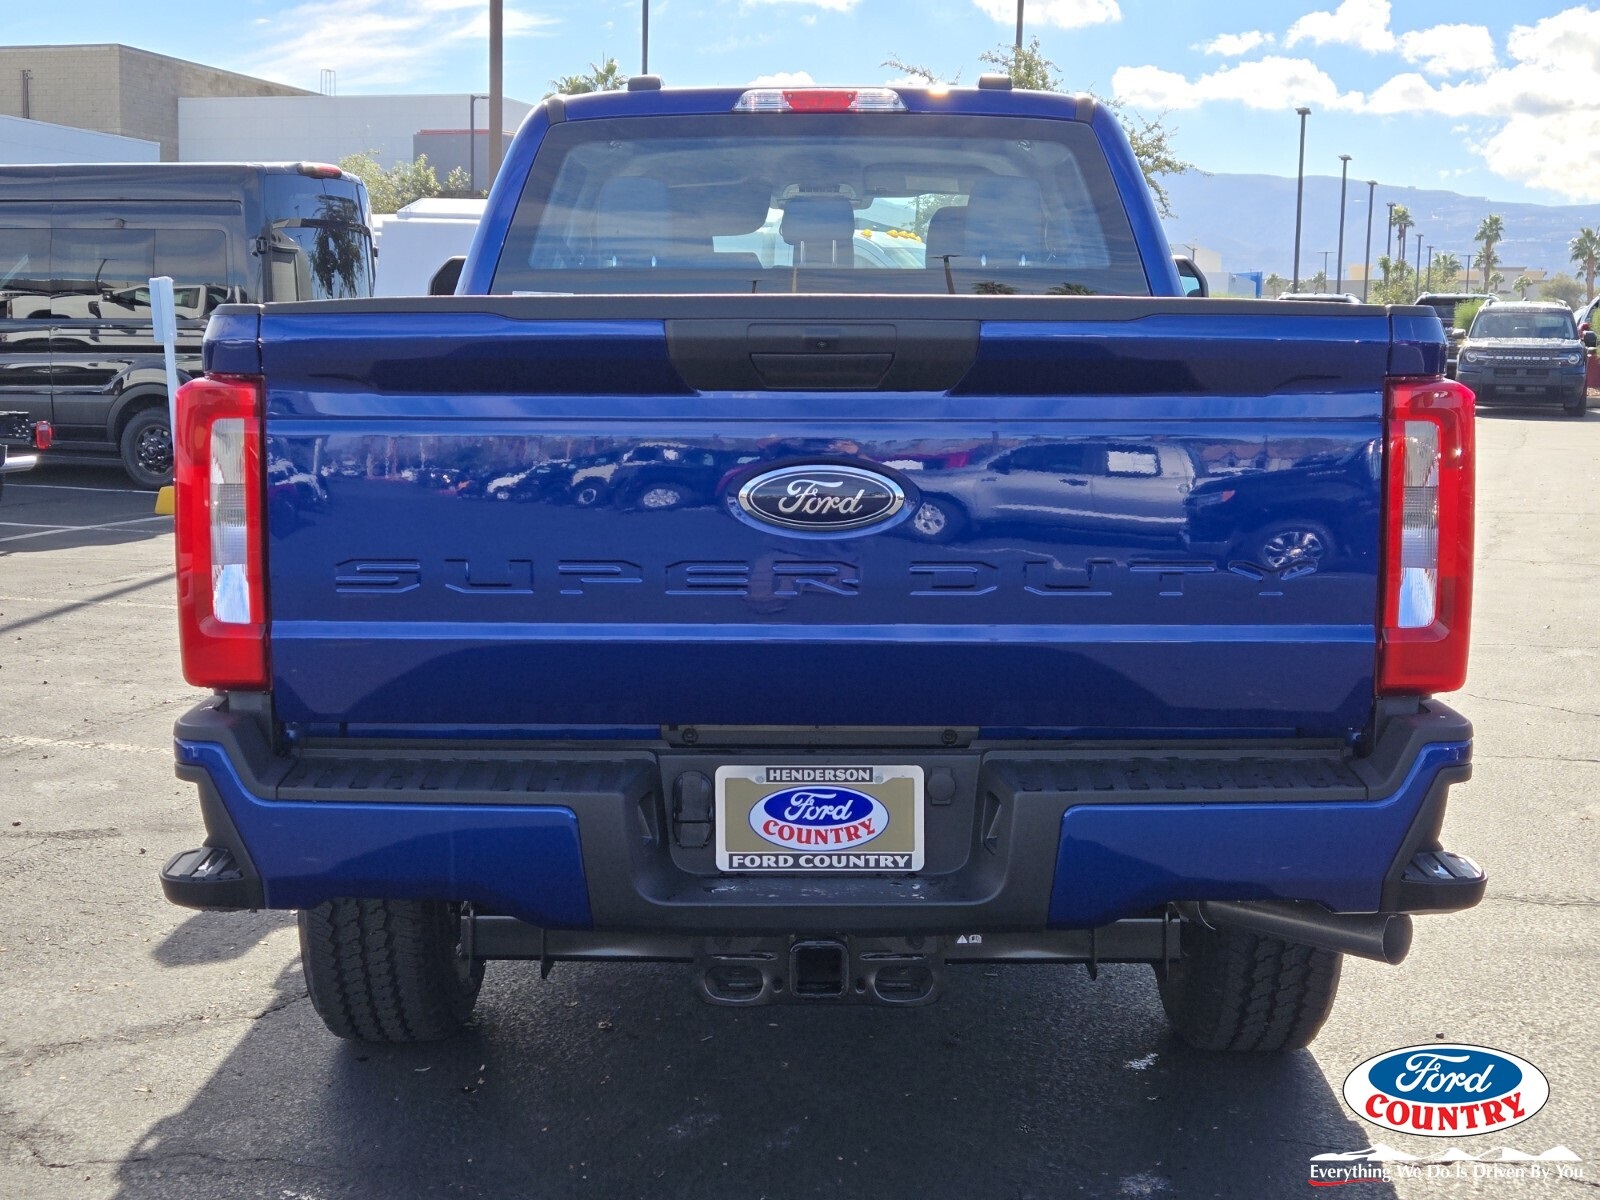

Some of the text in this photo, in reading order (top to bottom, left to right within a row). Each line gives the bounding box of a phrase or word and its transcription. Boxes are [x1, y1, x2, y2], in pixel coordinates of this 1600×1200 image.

[777, 479, 864, 514] Ford
[335, 558, 1317, 597] SUPER DUTY
[768, 768, 871, 782] HENDERSON
[783, 791, 853, 821] Ford
[762, 818, 876, 845] COUNTRY
[732, 855, 910, 868] FORD COUNTRY
